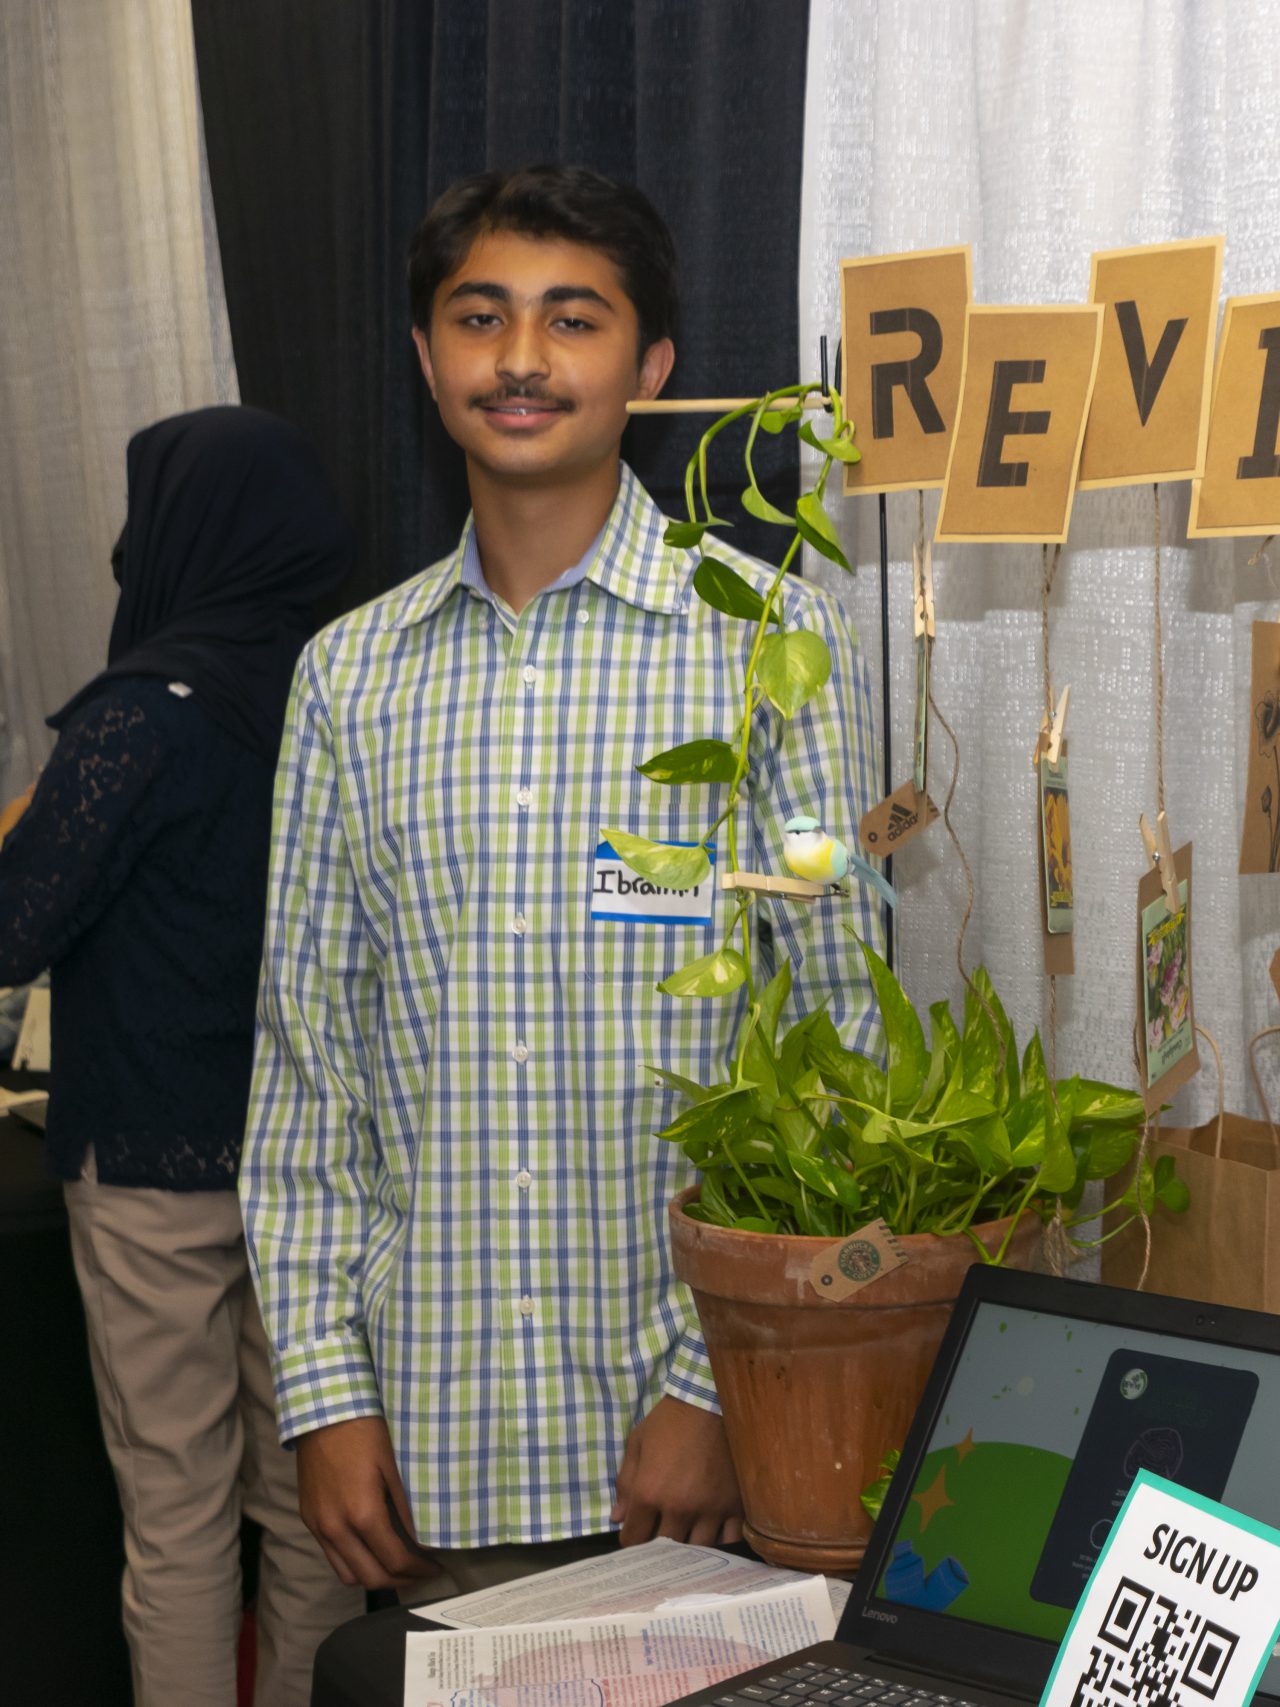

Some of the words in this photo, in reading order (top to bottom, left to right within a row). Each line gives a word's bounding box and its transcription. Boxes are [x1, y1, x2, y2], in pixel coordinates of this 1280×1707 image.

[887, 811, 919, 842] adida
[592, 869, 700, 898] Ibra
[1143, 1523, 1217, 1585] SIGN
[1212, 1554, 1260, 1602] UP
[862, 1605, 898, 1625] Lenovo
